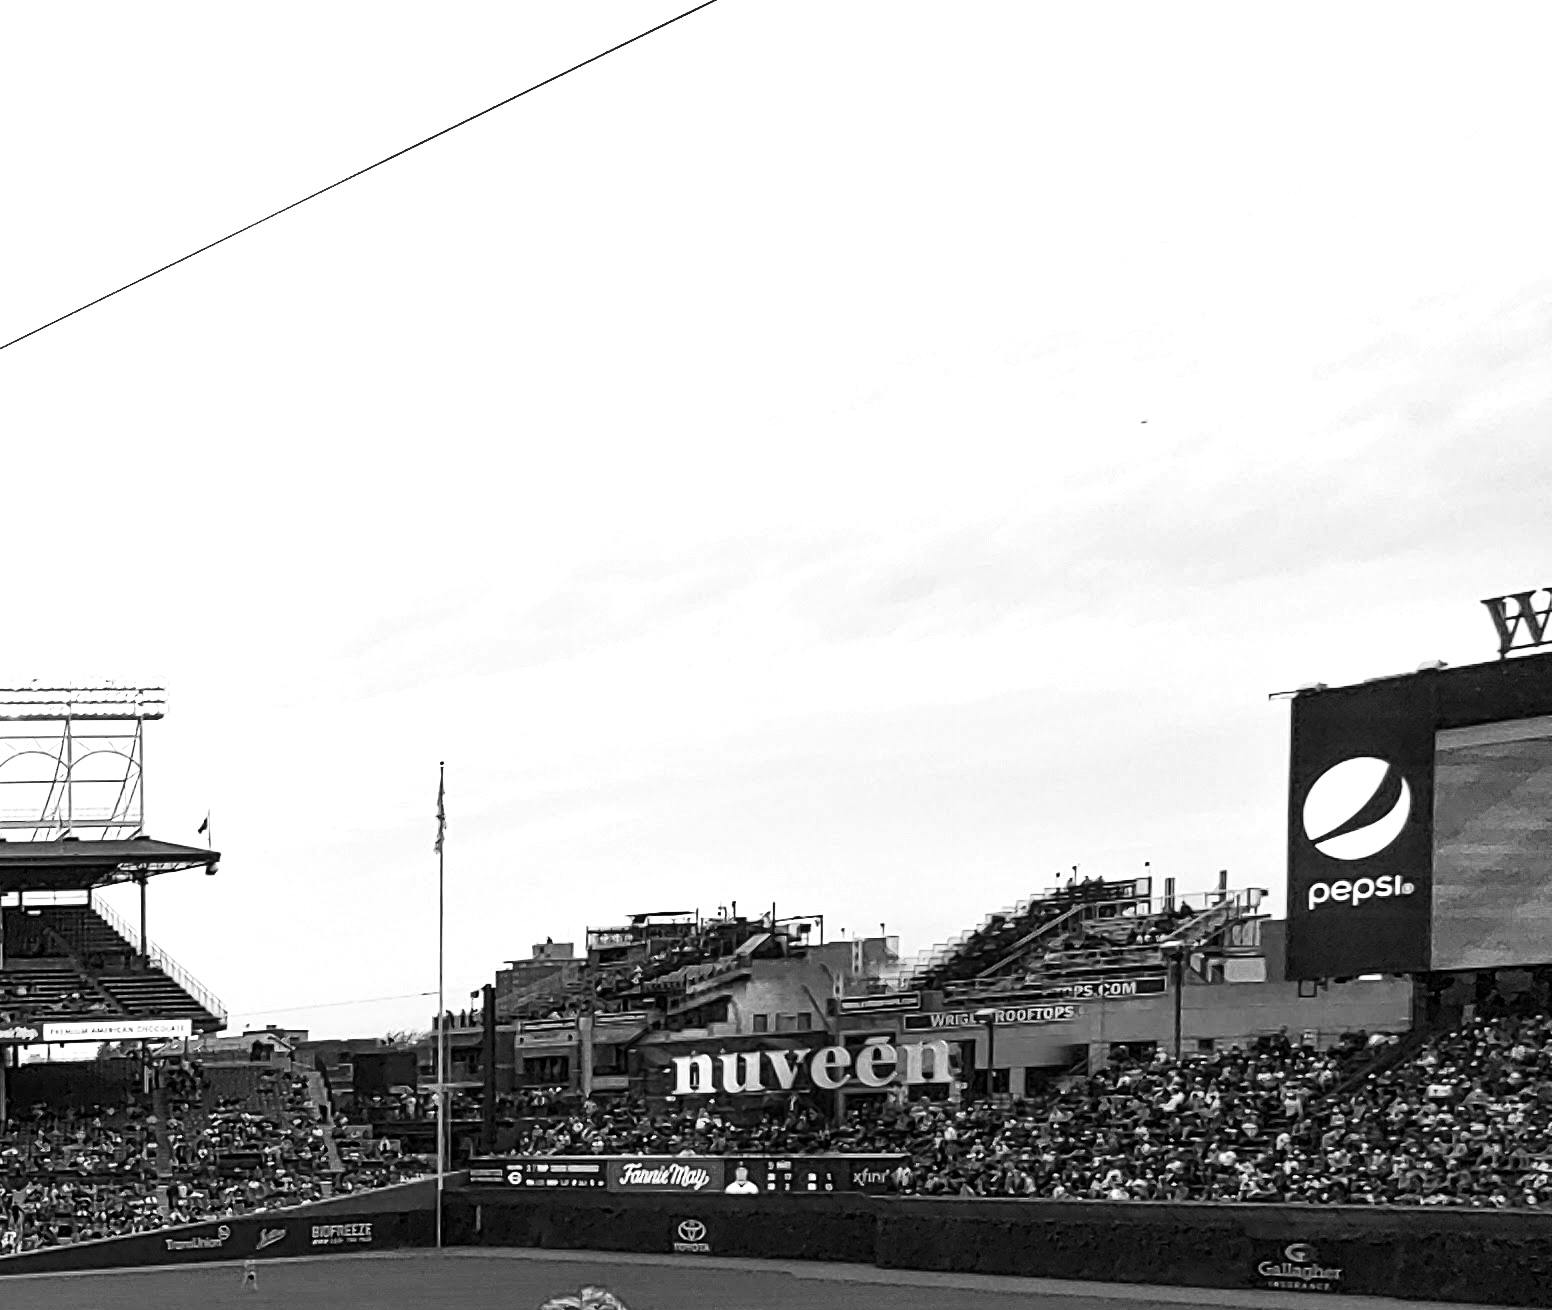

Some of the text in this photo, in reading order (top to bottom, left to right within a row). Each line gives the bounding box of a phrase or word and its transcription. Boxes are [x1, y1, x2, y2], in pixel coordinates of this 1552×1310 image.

[1308, 874, 1402, 911] pepsi
[930, 1005, 1075, 1028] WRIGLROOFTOPS
[618, 1162, 711, 1191] Fannie May
